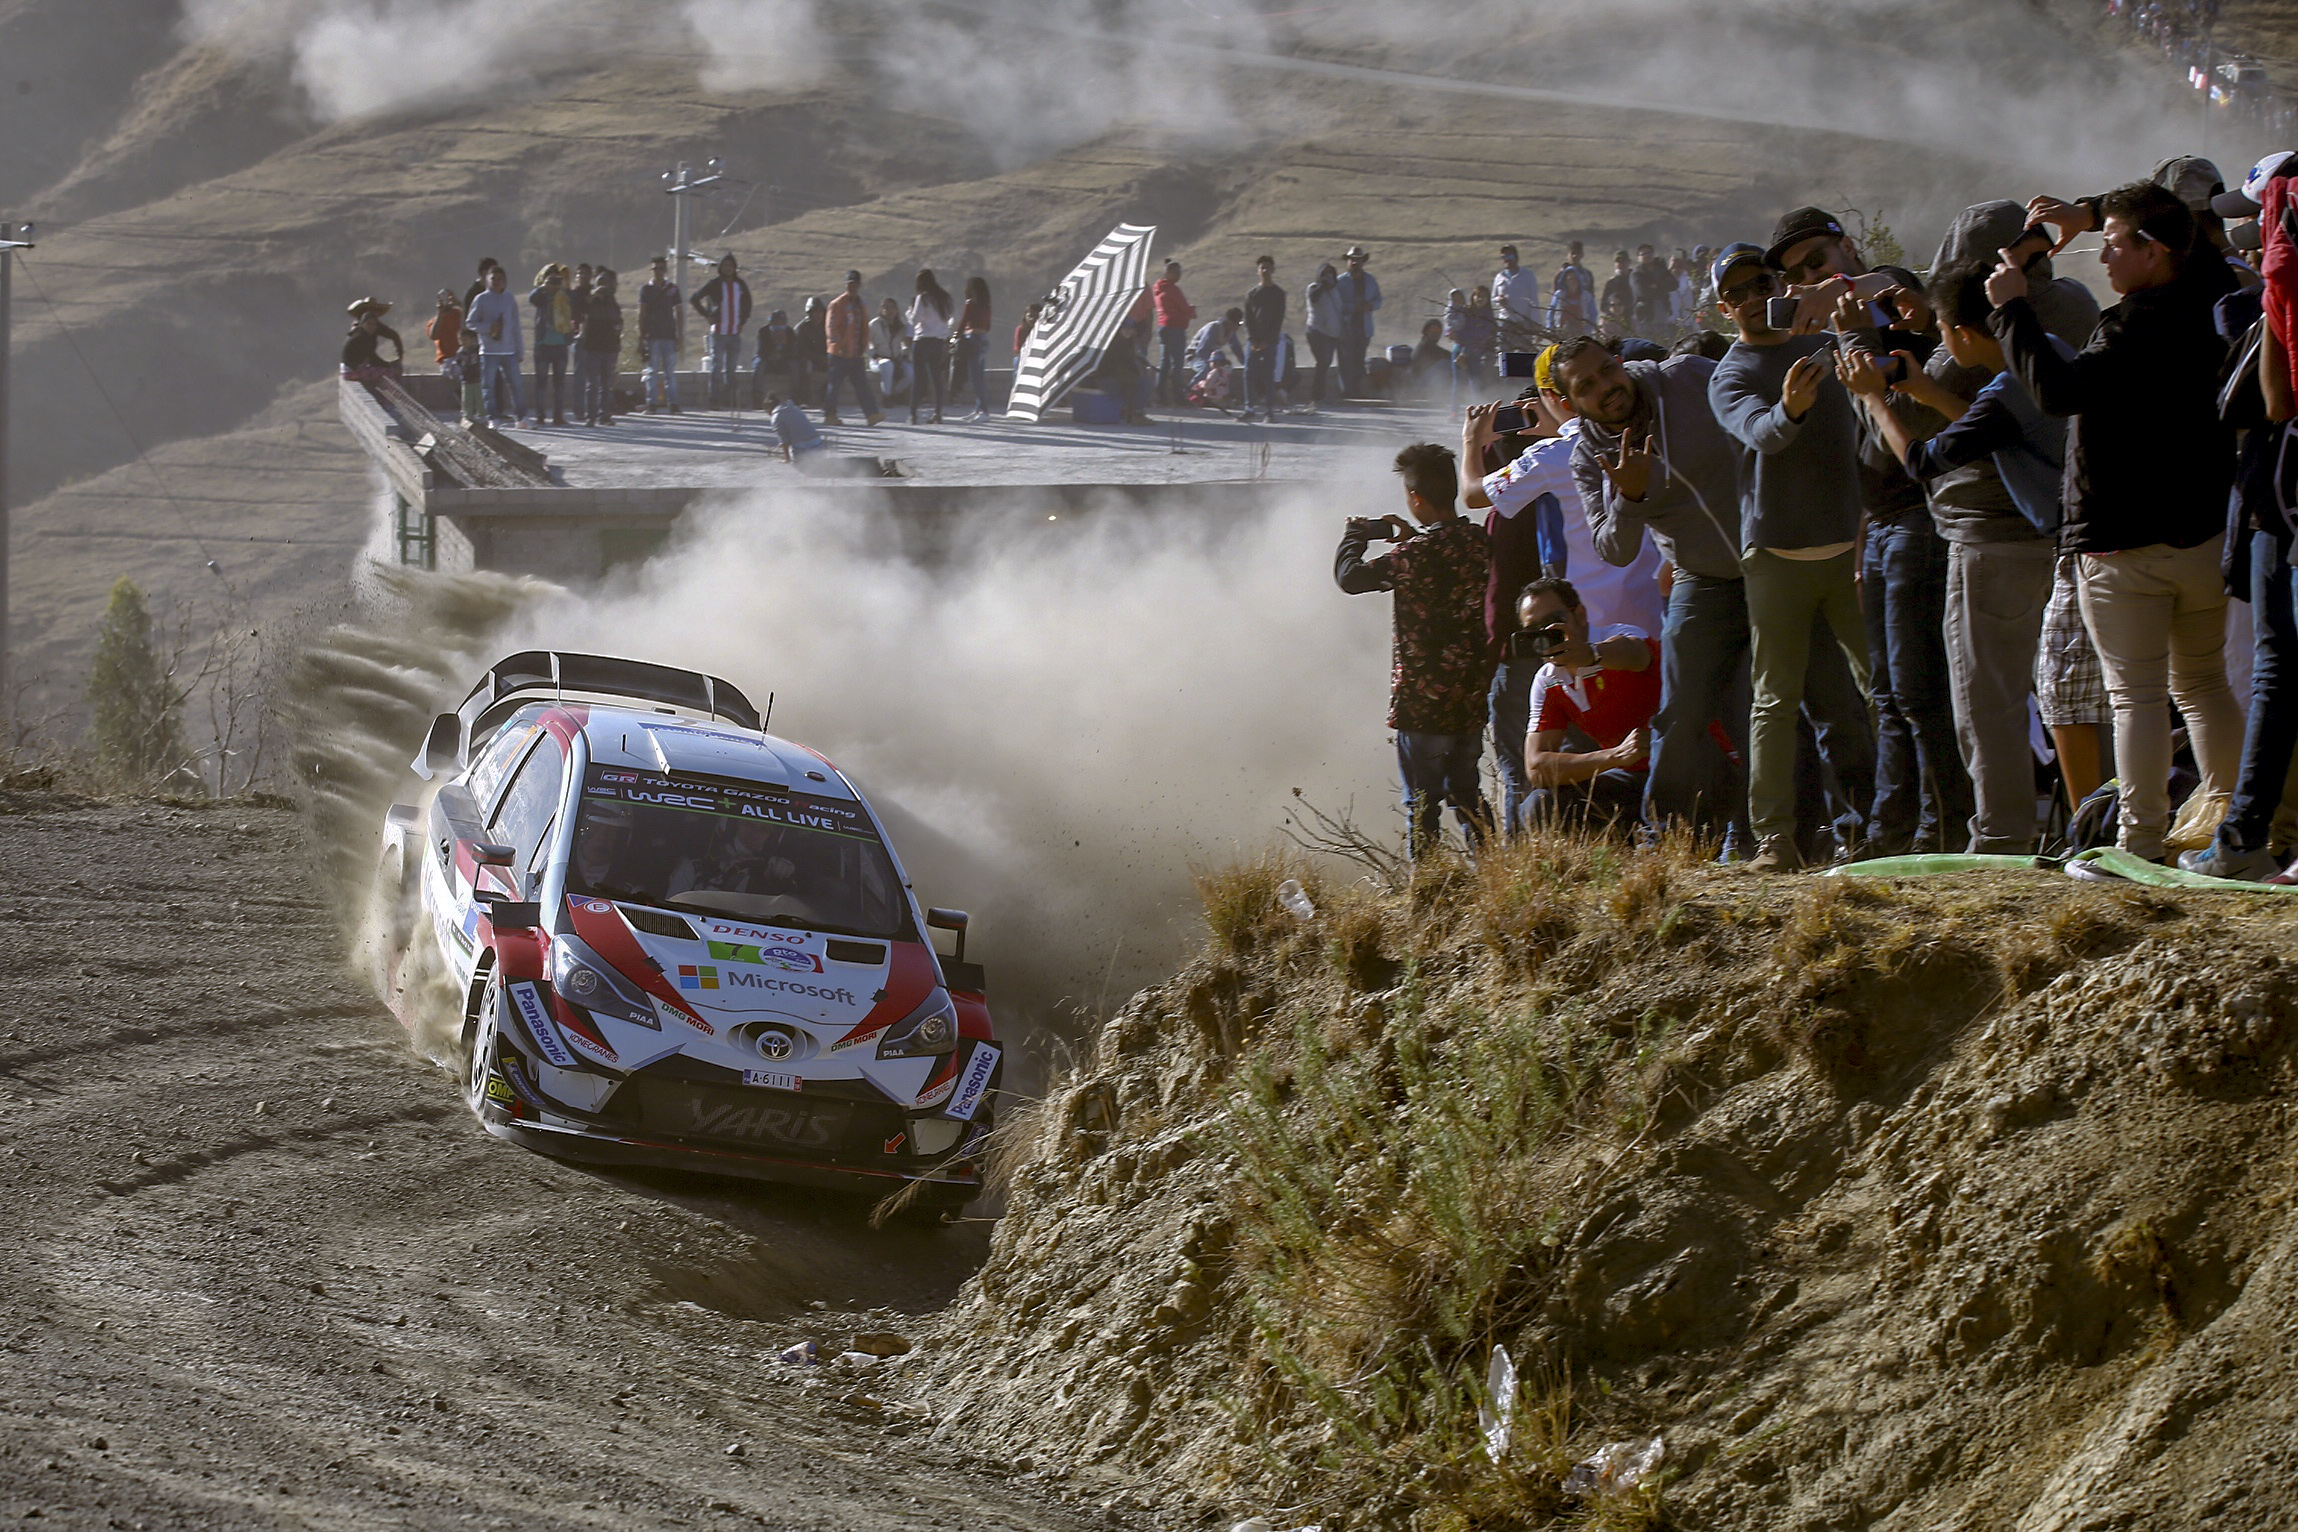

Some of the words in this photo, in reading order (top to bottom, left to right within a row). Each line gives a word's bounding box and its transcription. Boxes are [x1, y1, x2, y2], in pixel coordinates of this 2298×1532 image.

[602, 774, 636, 783] GR
[643, 777, 719, 793] TOYOTA
[723, 788, 790, 804] GAZOO
[741, 804, 782, 820] ALL
[787, 811, 835, 830] LIVE
[713, 925, 805, 944] DENSO
[725, 942, 744, 957] 7
[728, 971, 856, 1006] Microsoft
[516, 988, 567, 1062] Panasonic
[629, 1011, 654, 1025] PIAA
[661, 1003, 687, 1021] DMG
[686, 1017, 715, 1036] MORI
[568, 1033, 619, 1064] KONECRANES
[831, 1040, 853, 1053] DMG
[853, 1031, 878, 1046] MORI
[883, 1049, 905, 1058] PIAA
[488, 1081, 515, 1099] OMP
[950, 1050, 994, 1116] Panasonic
